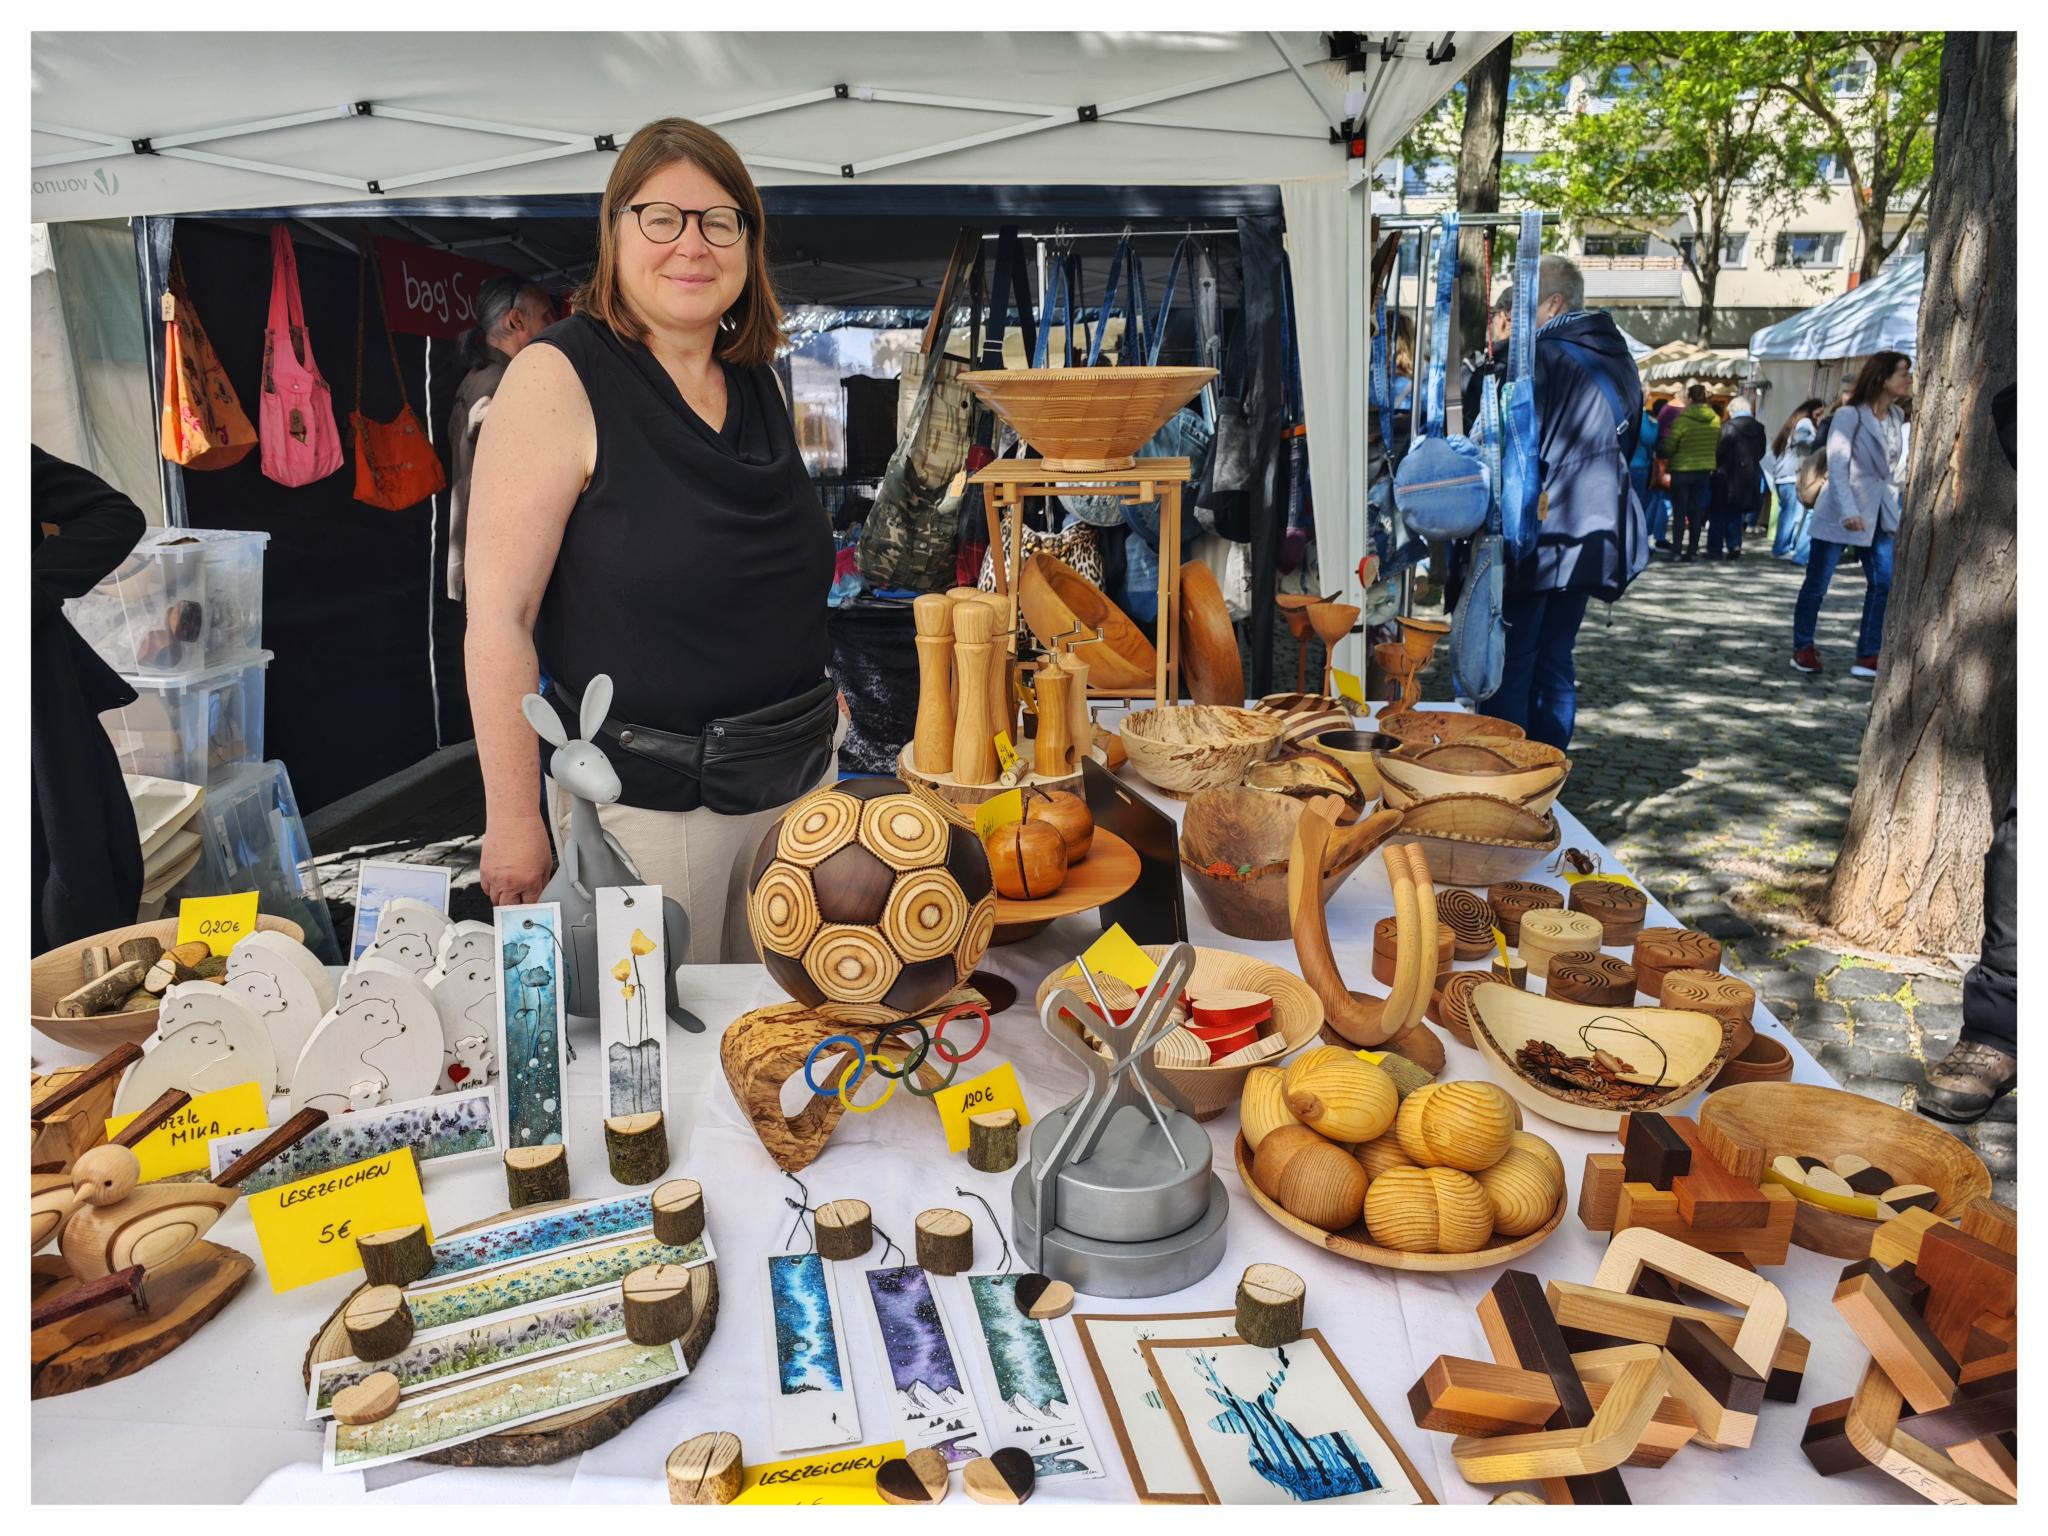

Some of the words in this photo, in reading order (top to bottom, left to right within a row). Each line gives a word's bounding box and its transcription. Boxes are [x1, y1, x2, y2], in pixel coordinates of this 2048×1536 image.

[199, 919, 241, 937] 0,20€
[460, 1078, 483, 1092] Mika
[159, 1108, 200, 1130] uzzle
[171, 1121, 220, 1147] MIKA
[279, 1160, 392, 1209] LESEZEICHEN
[318, 1219, 353, 1245] 5€
